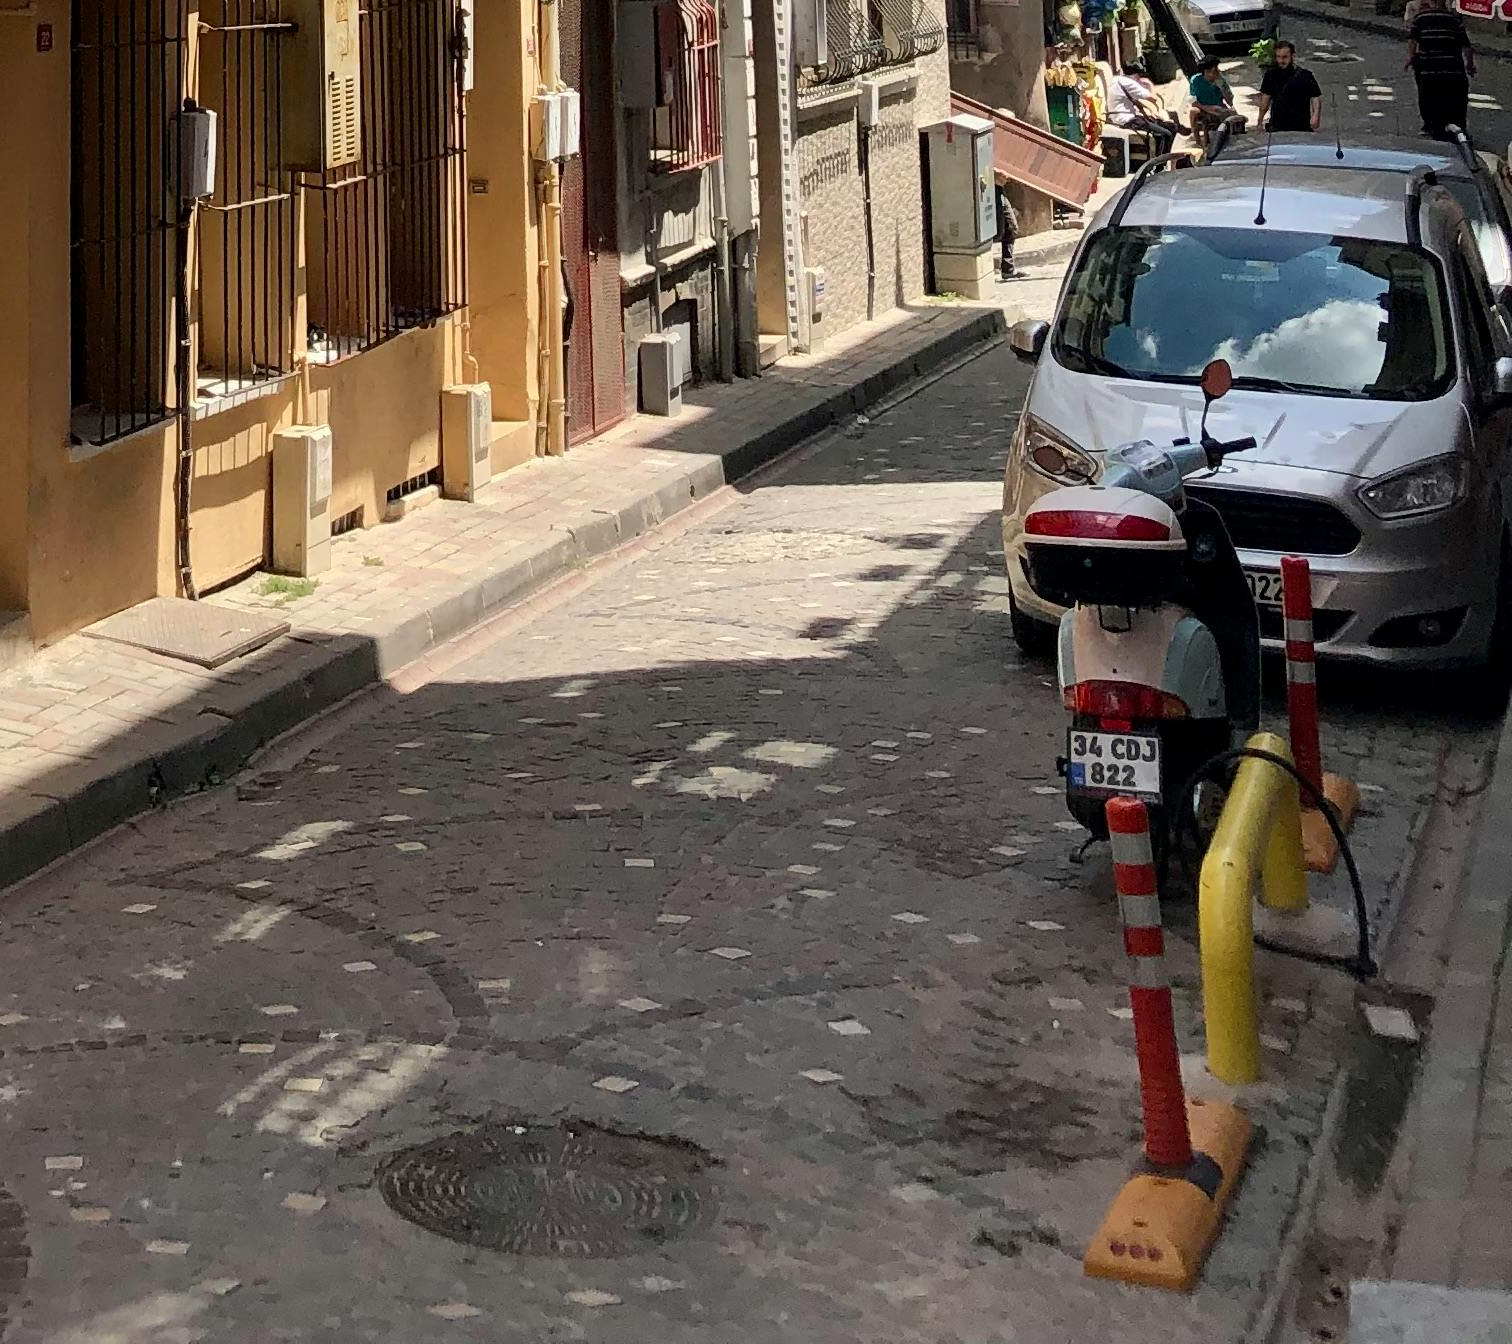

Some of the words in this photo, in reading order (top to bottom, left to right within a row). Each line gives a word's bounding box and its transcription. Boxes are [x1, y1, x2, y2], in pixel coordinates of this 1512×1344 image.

[1074, 735, 1103, 758] 34
[1110, 737, 1156, 762] CDJ
[1091, 762, 1136, 787] 822
